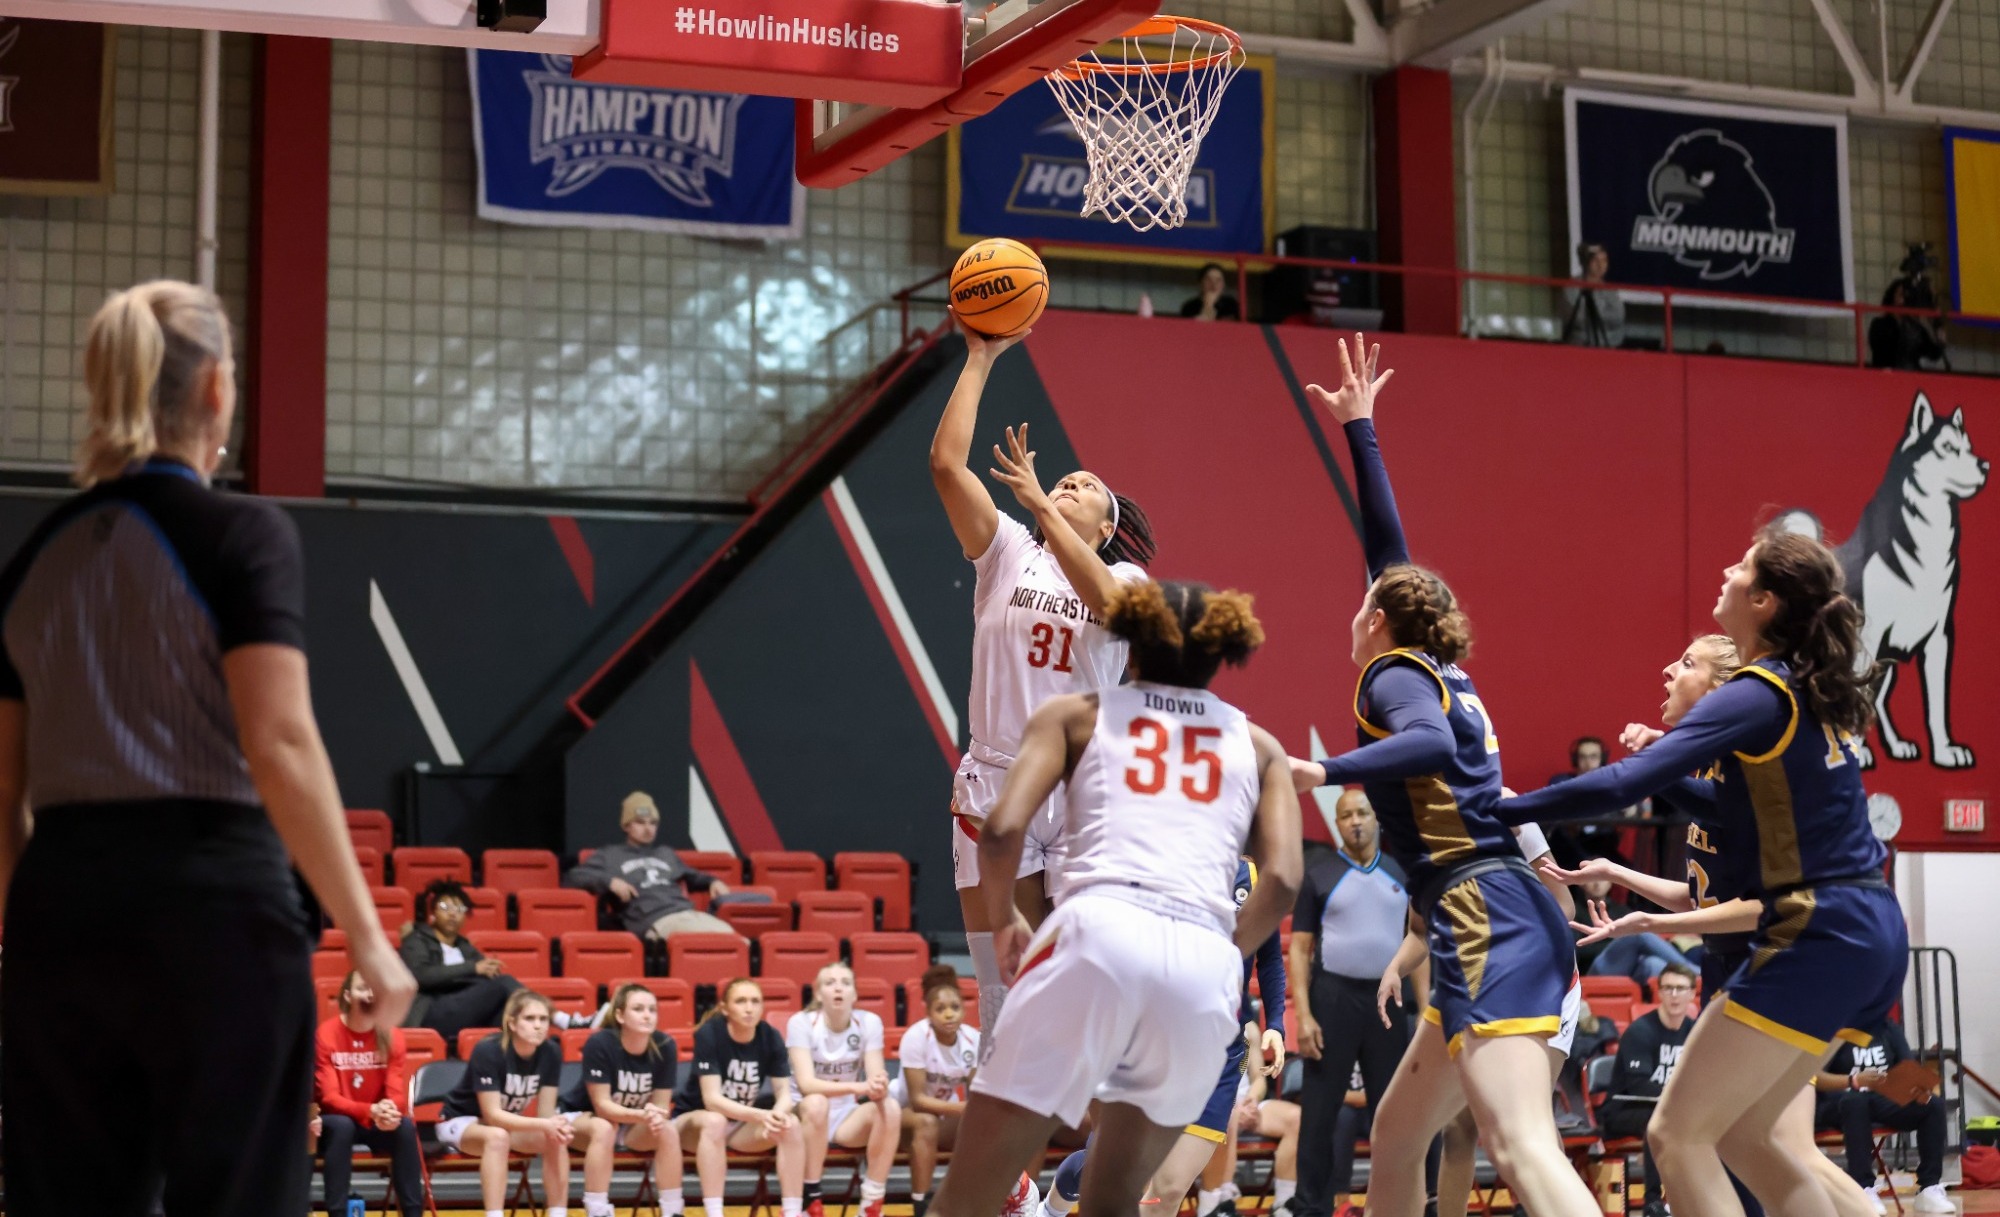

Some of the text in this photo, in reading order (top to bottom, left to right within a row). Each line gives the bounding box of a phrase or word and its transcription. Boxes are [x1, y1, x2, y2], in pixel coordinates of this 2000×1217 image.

[674, 6, 900, 53] #HowlinHuskies
[542, 86, 727, 157] HAMPTON
[572, 139, 685, 166] PIRATES
[1636, 221, 1791, 257] MONMOUTH
[955, 275, 1017, 303] Wilson
[1009, 586, 1105, 627] NORTHEAST
[1027, 622, 1074, 674] 31
[1144, 692, 1206, 716] IDOWU
[1124, 716, 1223, 804] 35
[1953, 803, 1980, 828] EXIT
[1852, 1045, 1887, 1067] WE
[505, 1073, 540, 1096] WE
[618, 1069, 653, 1093] WE
